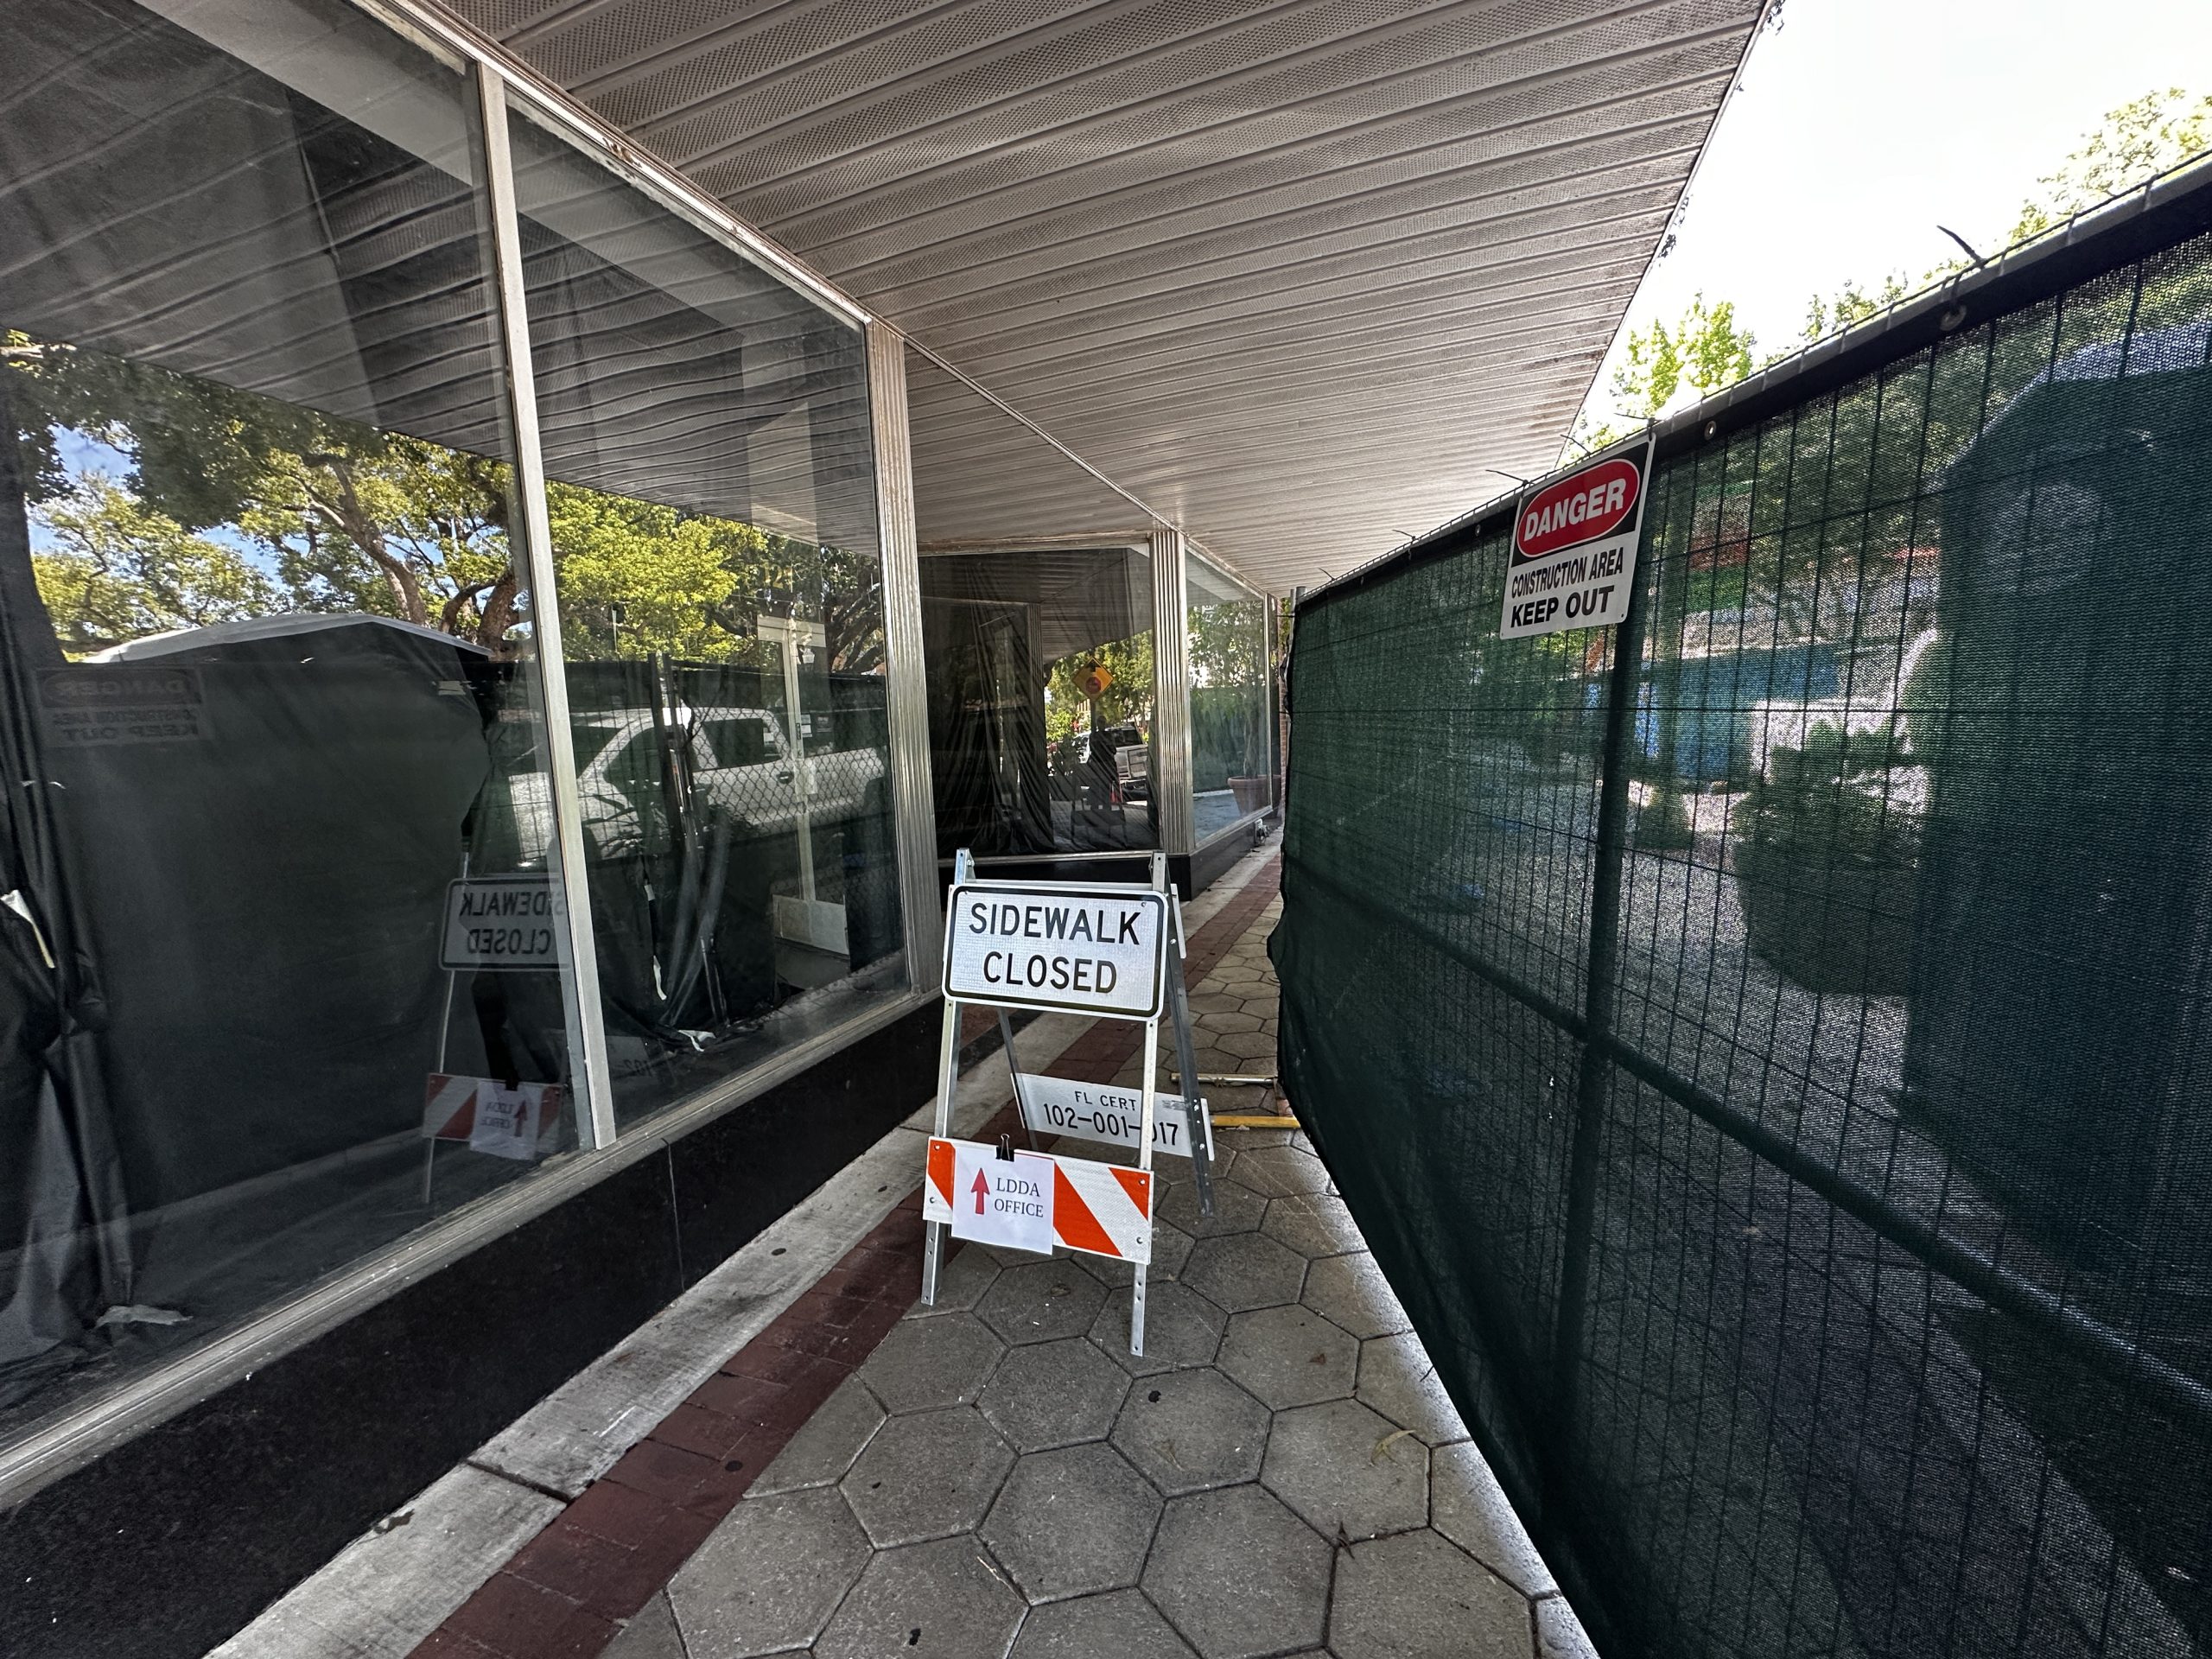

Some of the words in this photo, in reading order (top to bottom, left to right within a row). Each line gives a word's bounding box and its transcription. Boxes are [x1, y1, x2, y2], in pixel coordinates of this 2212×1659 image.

[1523, 478, 1626, 542] DANGER
[1512, 556, 1587, 598] CONSTRUCTION
[1589, 547, 1624, 581] AREA
[1510, 597, 1559, 627] KEEP
[1565, 585, 1614, 619] OUT
[969, 902, 1141, 945] SIDEWALK
[983, 951, 1117, 994] CLOSED
[1075, 1090, 1093, 1105] FL
[1100, 1094, 1137, 1112] CERT
[994, 1198, 1044, 1218] OFFICE
[995, 1177, 1041, 1198] LDDA
